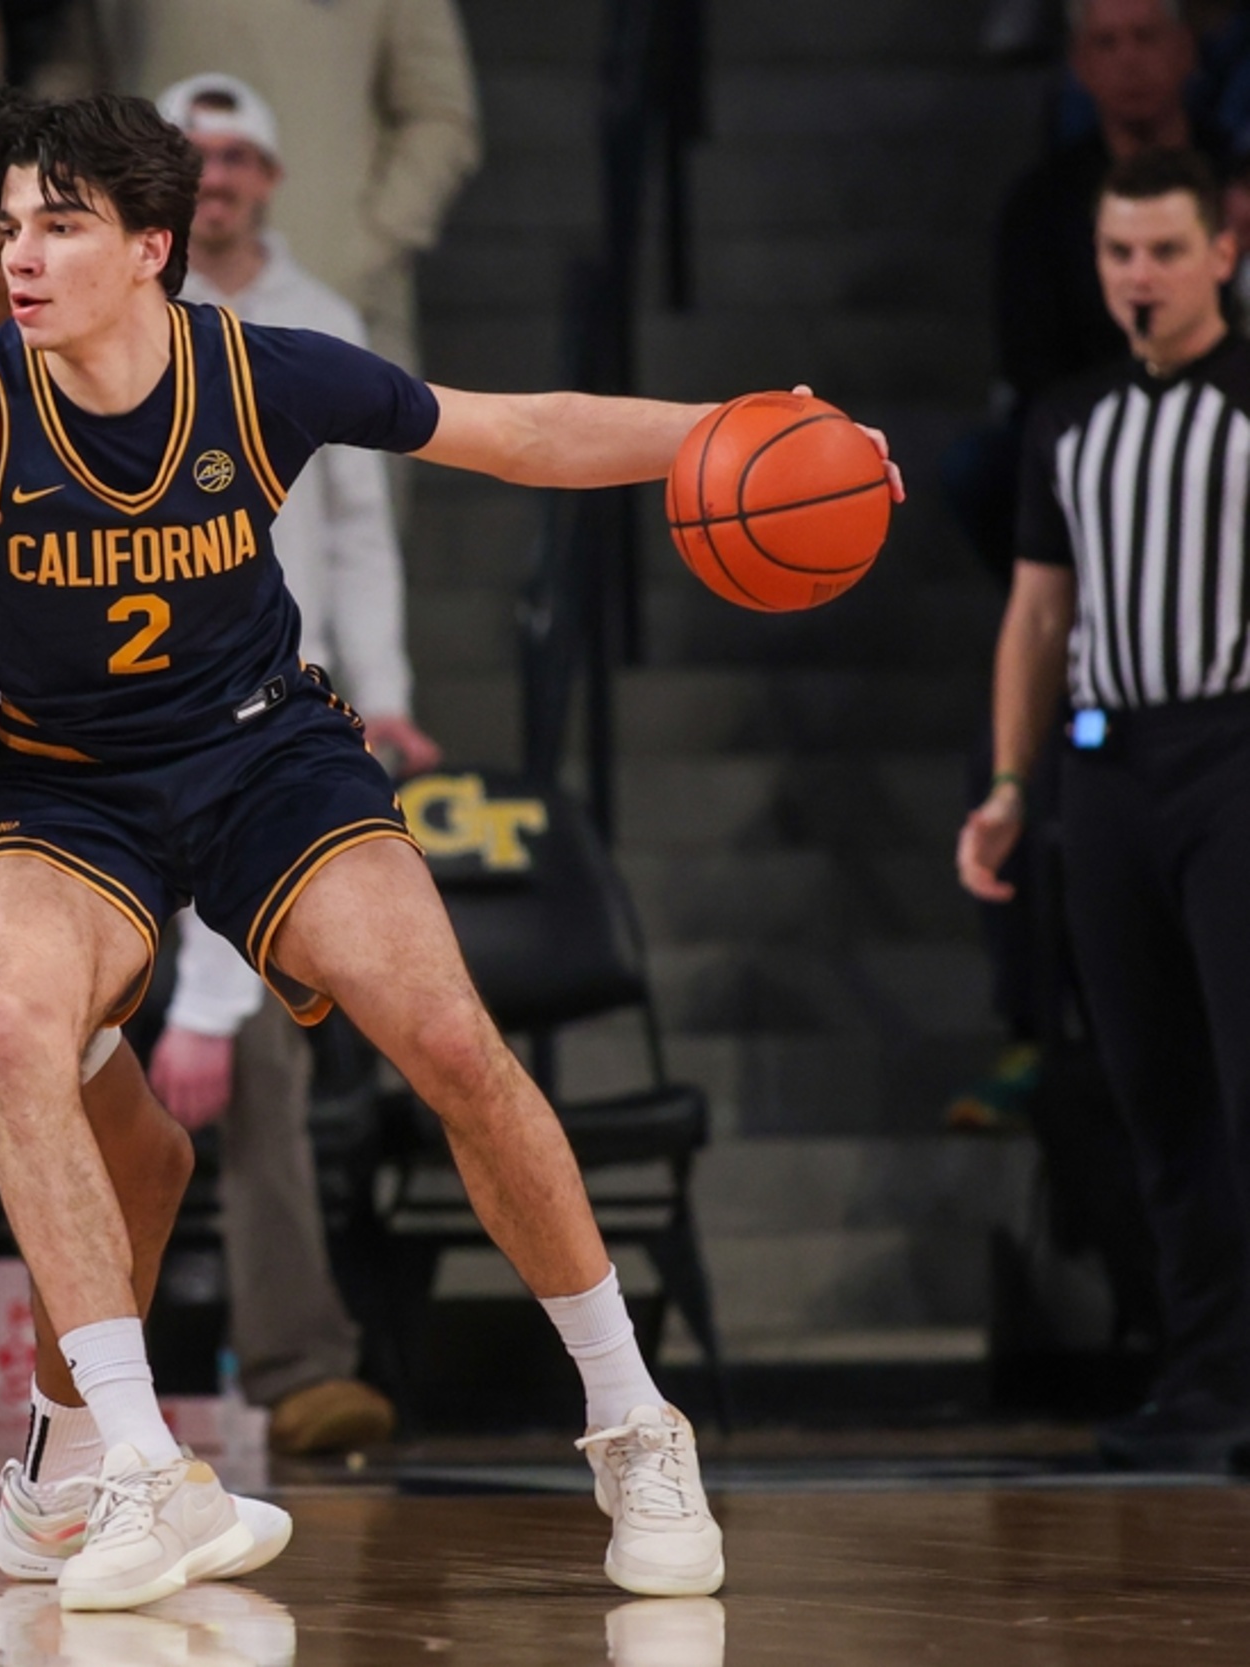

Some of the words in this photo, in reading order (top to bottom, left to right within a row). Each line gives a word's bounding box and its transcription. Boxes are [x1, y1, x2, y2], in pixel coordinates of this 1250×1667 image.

[8, 508, 256, 587] CALIFORNIA
[107, 593, 170, 675] 2
[400, 773, 548, 870] GT
